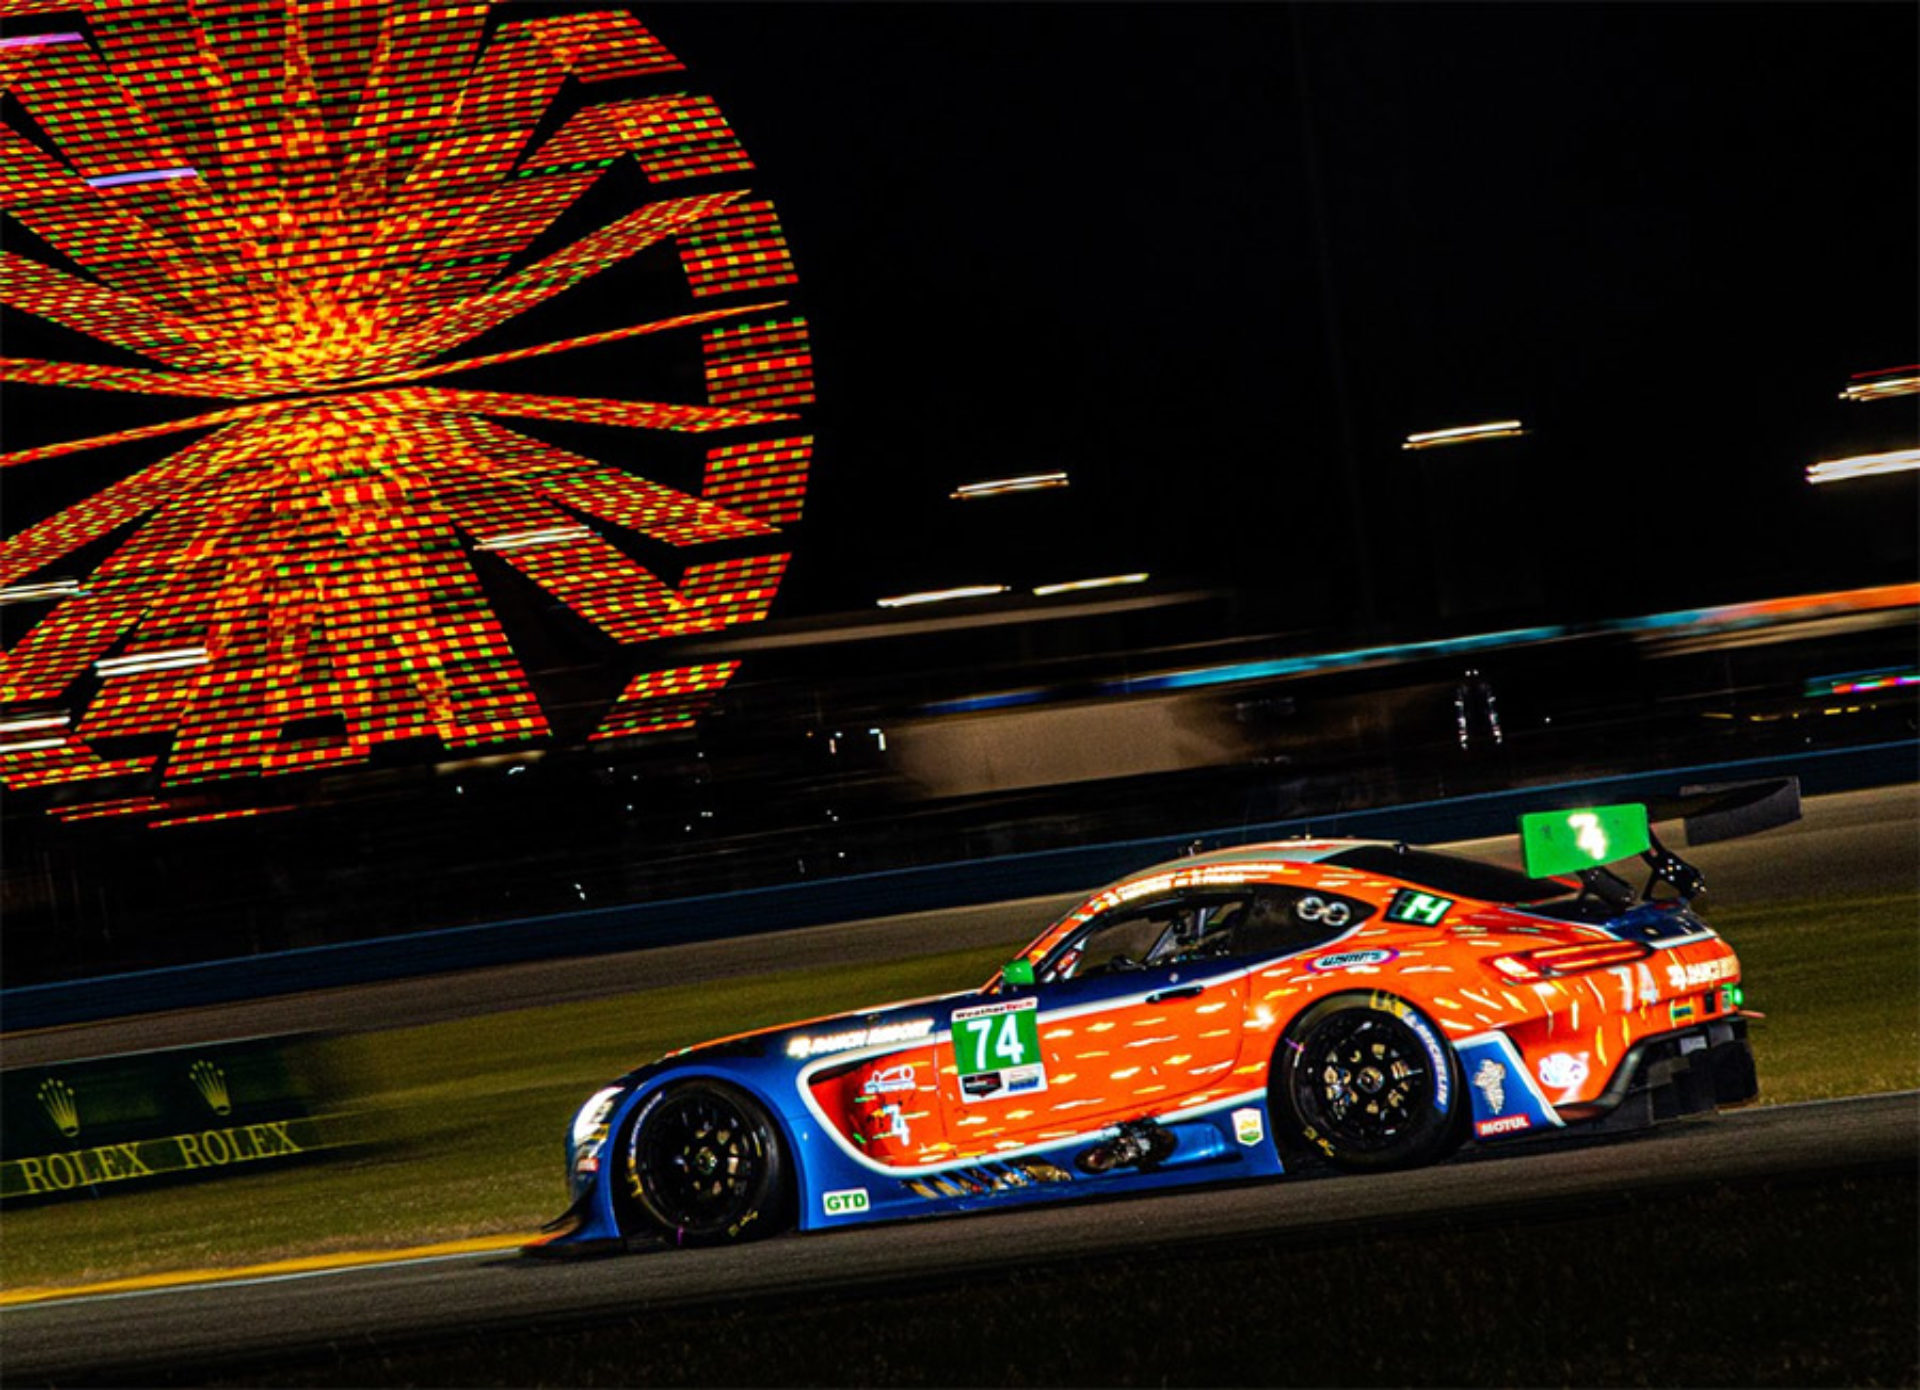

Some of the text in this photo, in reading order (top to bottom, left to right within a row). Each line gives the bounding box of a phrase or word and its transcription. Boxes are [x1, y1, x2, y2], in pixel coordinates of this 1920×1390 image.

[966, 1013, 1024, 1070] 74
[1481, 1116, 1529, 1135] MOTUL
[17, 1120, 304, 1194] ROLEX ROLEX
[826, 1193, 868, 1211] GTD
